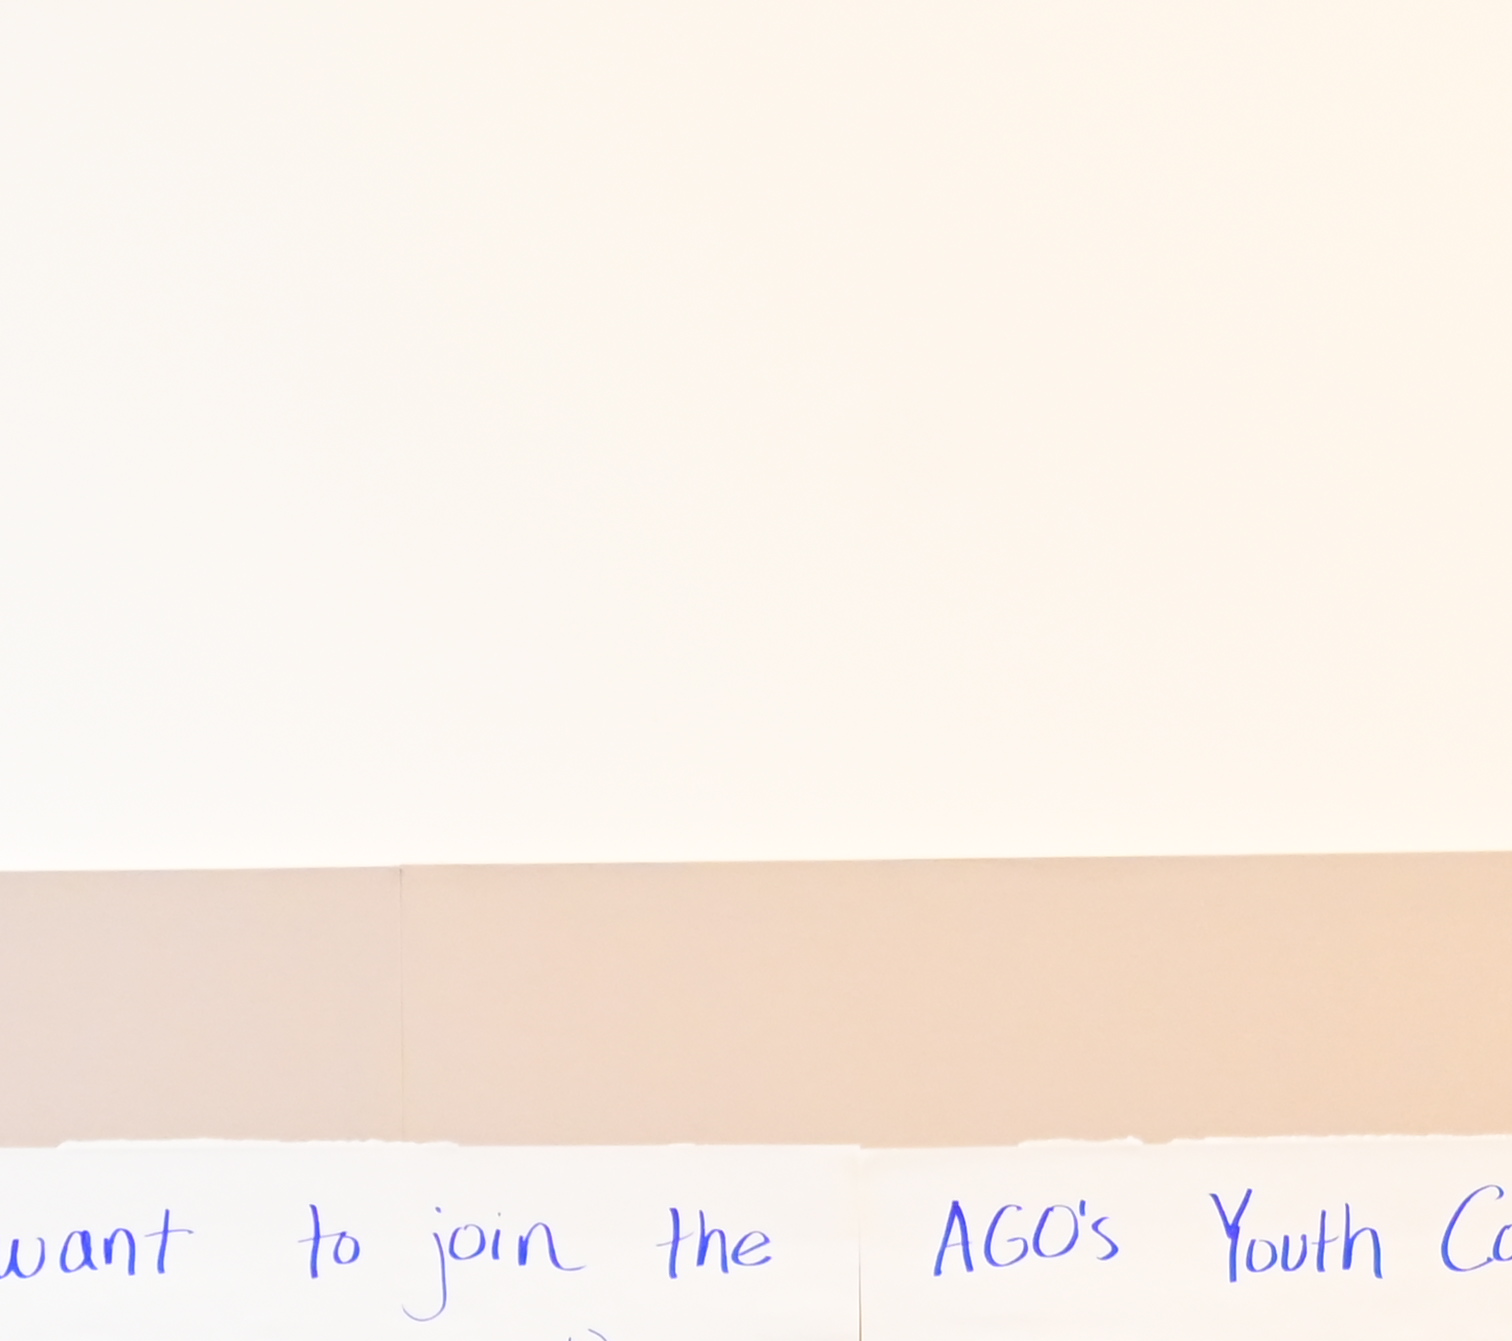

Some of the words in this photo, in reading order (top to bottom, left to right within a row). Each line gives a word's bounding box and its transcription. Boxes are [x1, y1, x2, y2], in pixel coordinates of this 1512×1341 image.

[298, 1203, 361, 1280] to
[402, 1206, 586, 1322] join
[656, 1207, 772, 1279] the
[932, 1200, 1120, 1277] AGO's
[1209, 1188, 1383, 1282] Youth
